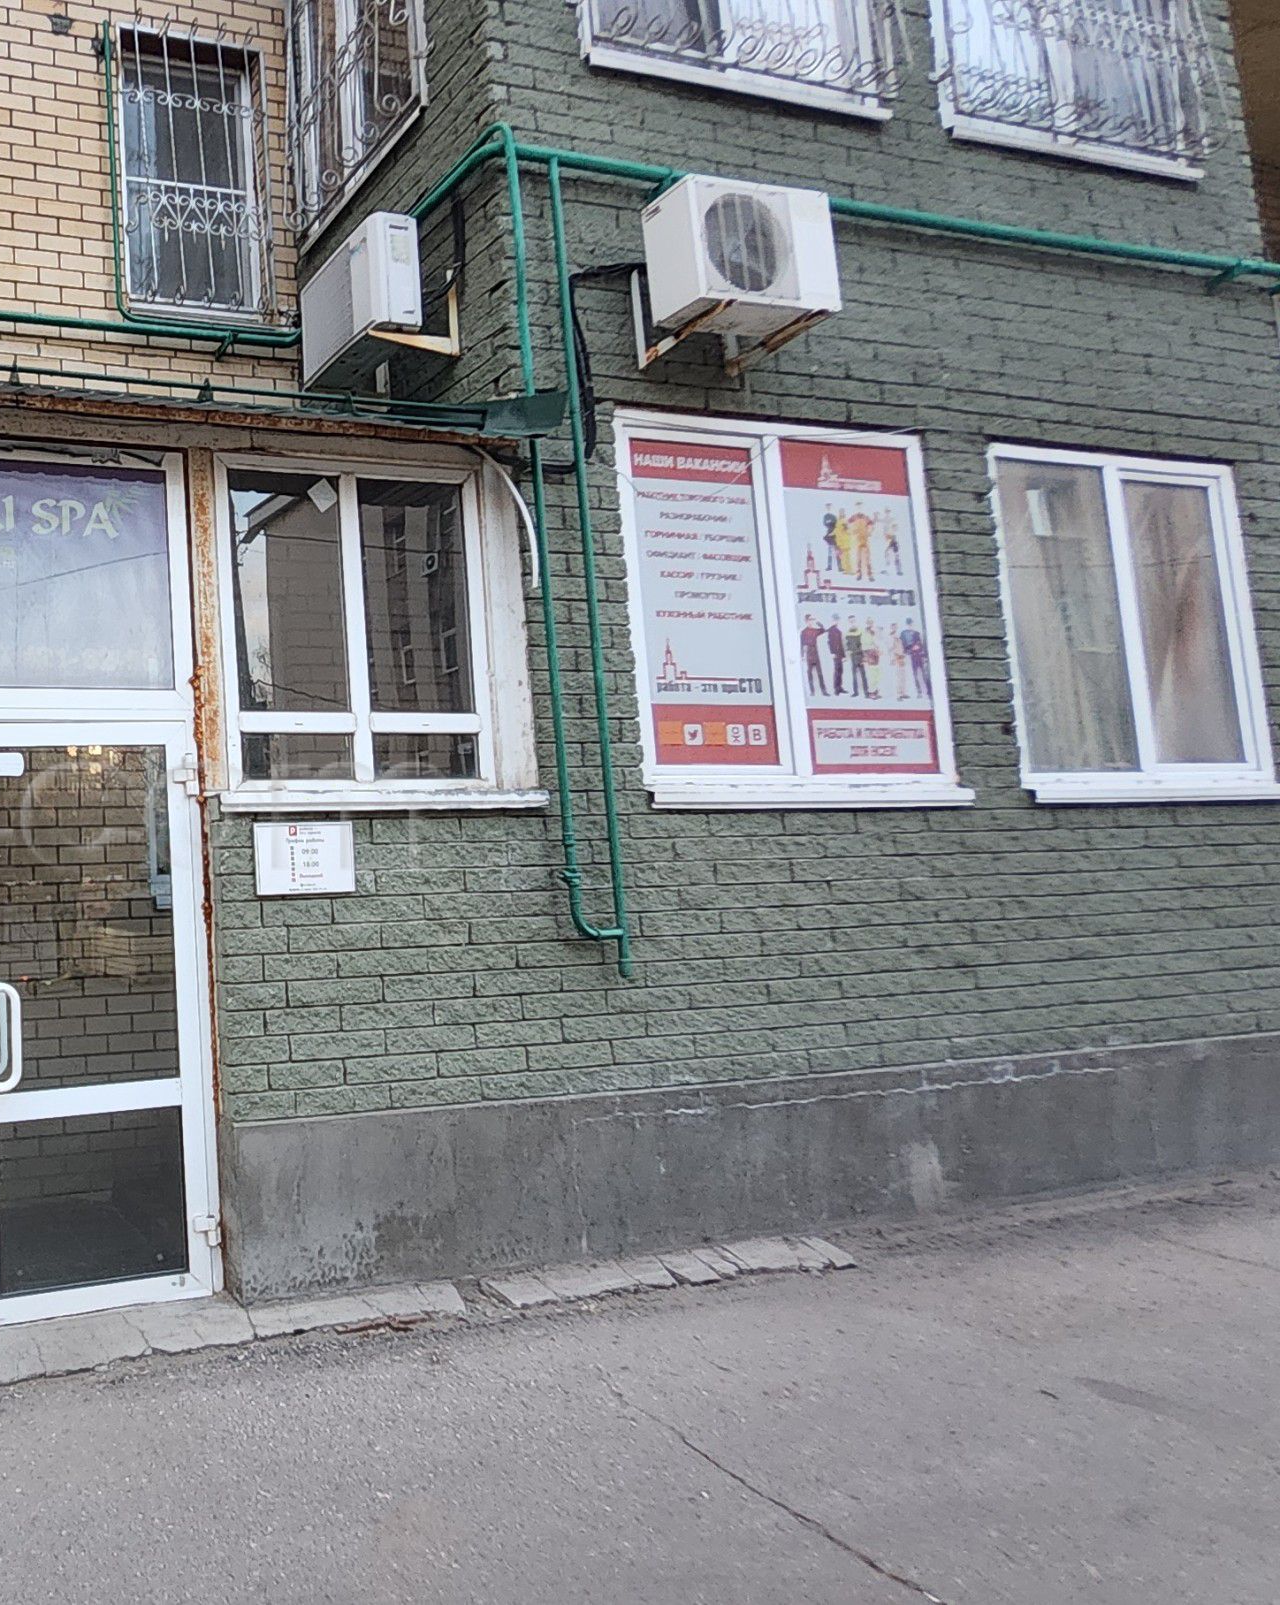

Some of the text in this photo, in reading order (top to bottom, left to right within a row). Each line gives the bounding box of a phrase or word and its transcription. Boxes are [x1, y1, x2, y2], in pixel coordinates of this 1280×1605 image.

[633, 453, 747, 474] НАШИ ВАКАНСИИ
[31, 498, 120, 540] SPA
